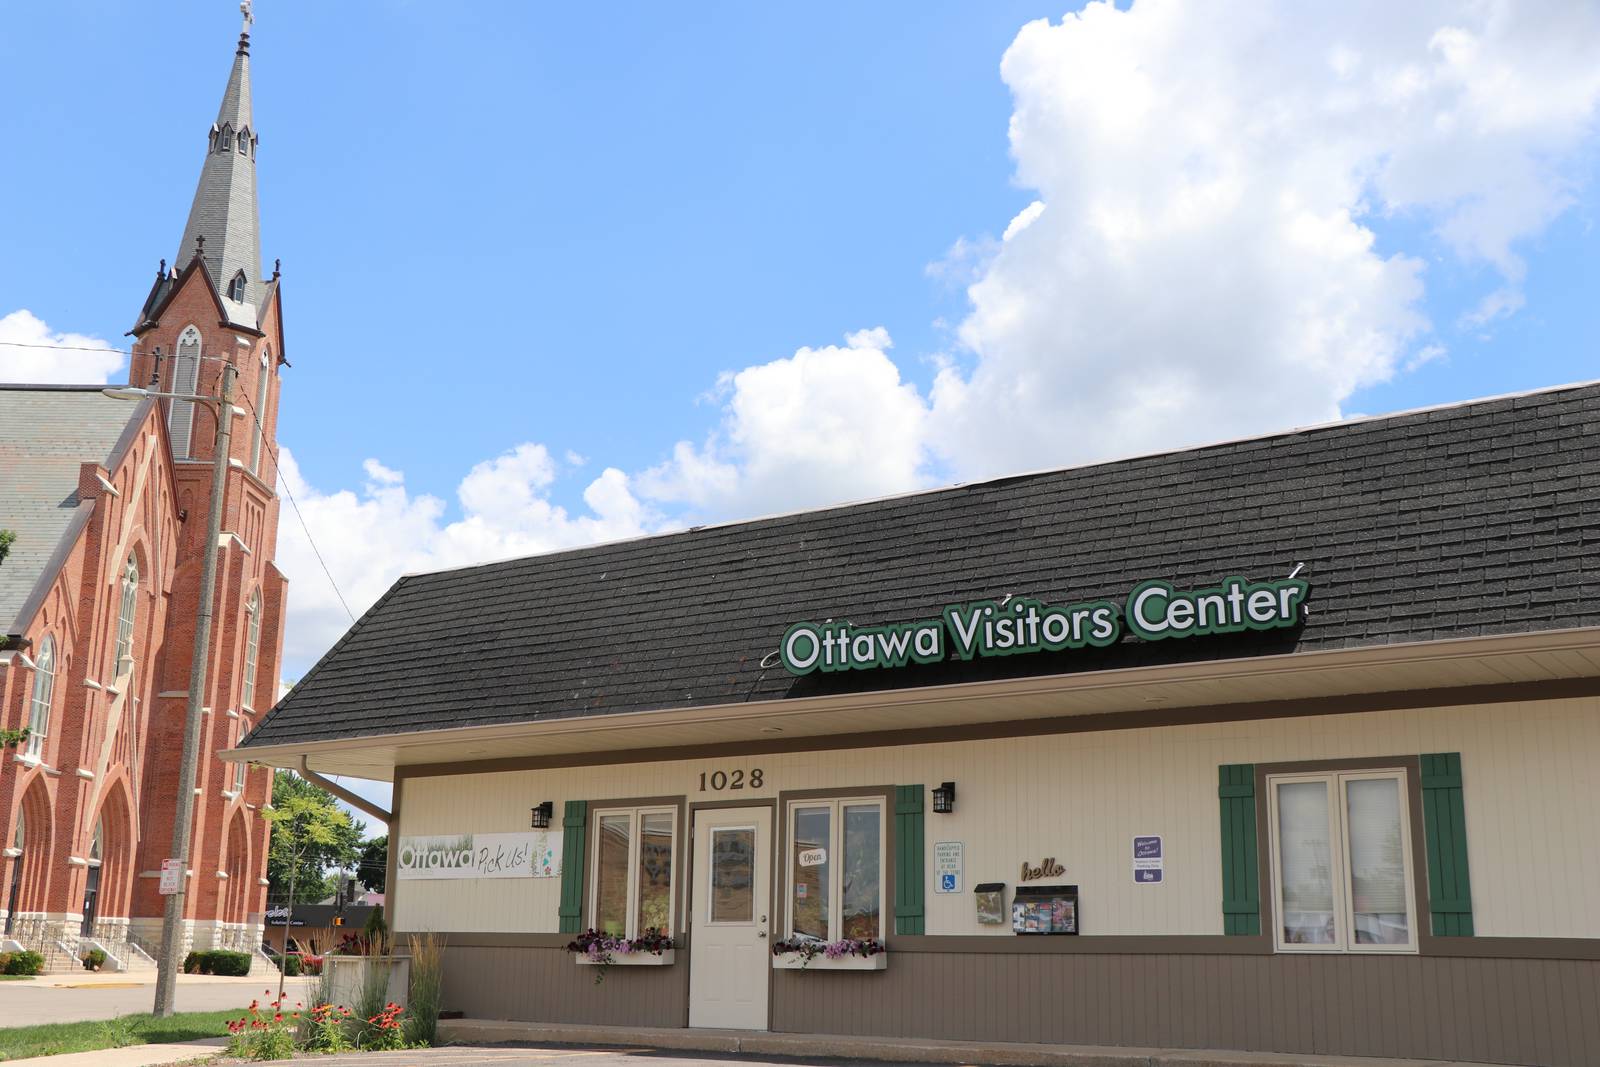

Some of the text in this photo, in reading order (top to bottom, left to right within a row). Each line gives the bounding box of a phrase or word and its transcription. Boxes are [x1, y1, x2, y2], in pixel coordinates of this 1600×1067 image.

[785, 582, 1300, 669] Ottawa Visitors Center
[699, 768, 764, 792] 1028
[400, 845, 475, 869] Ottawa
[803, 852, 822, 864] Open
[1021, 857, 1065, 881] hello
